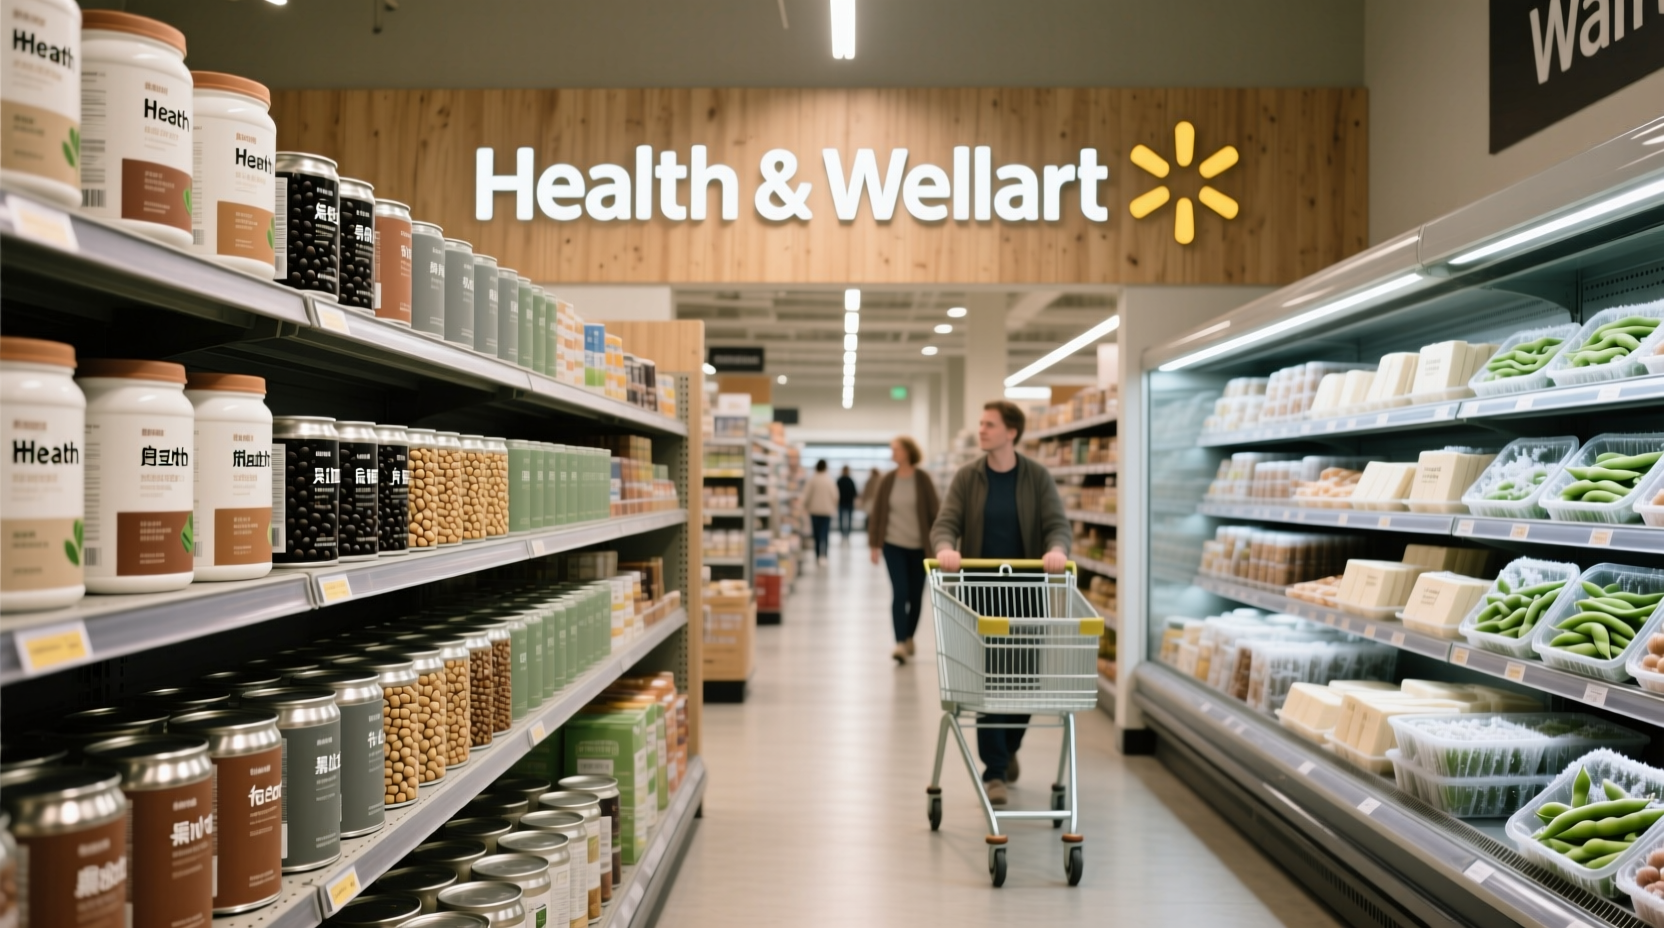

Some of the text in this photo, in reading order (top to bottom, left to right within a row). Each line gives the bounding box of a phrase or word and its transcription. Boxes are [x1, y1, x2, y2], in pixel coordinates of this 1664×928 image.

[144, 98, 190, 132] Heath
[475, 145, 1109, 222] Health & Wellart
